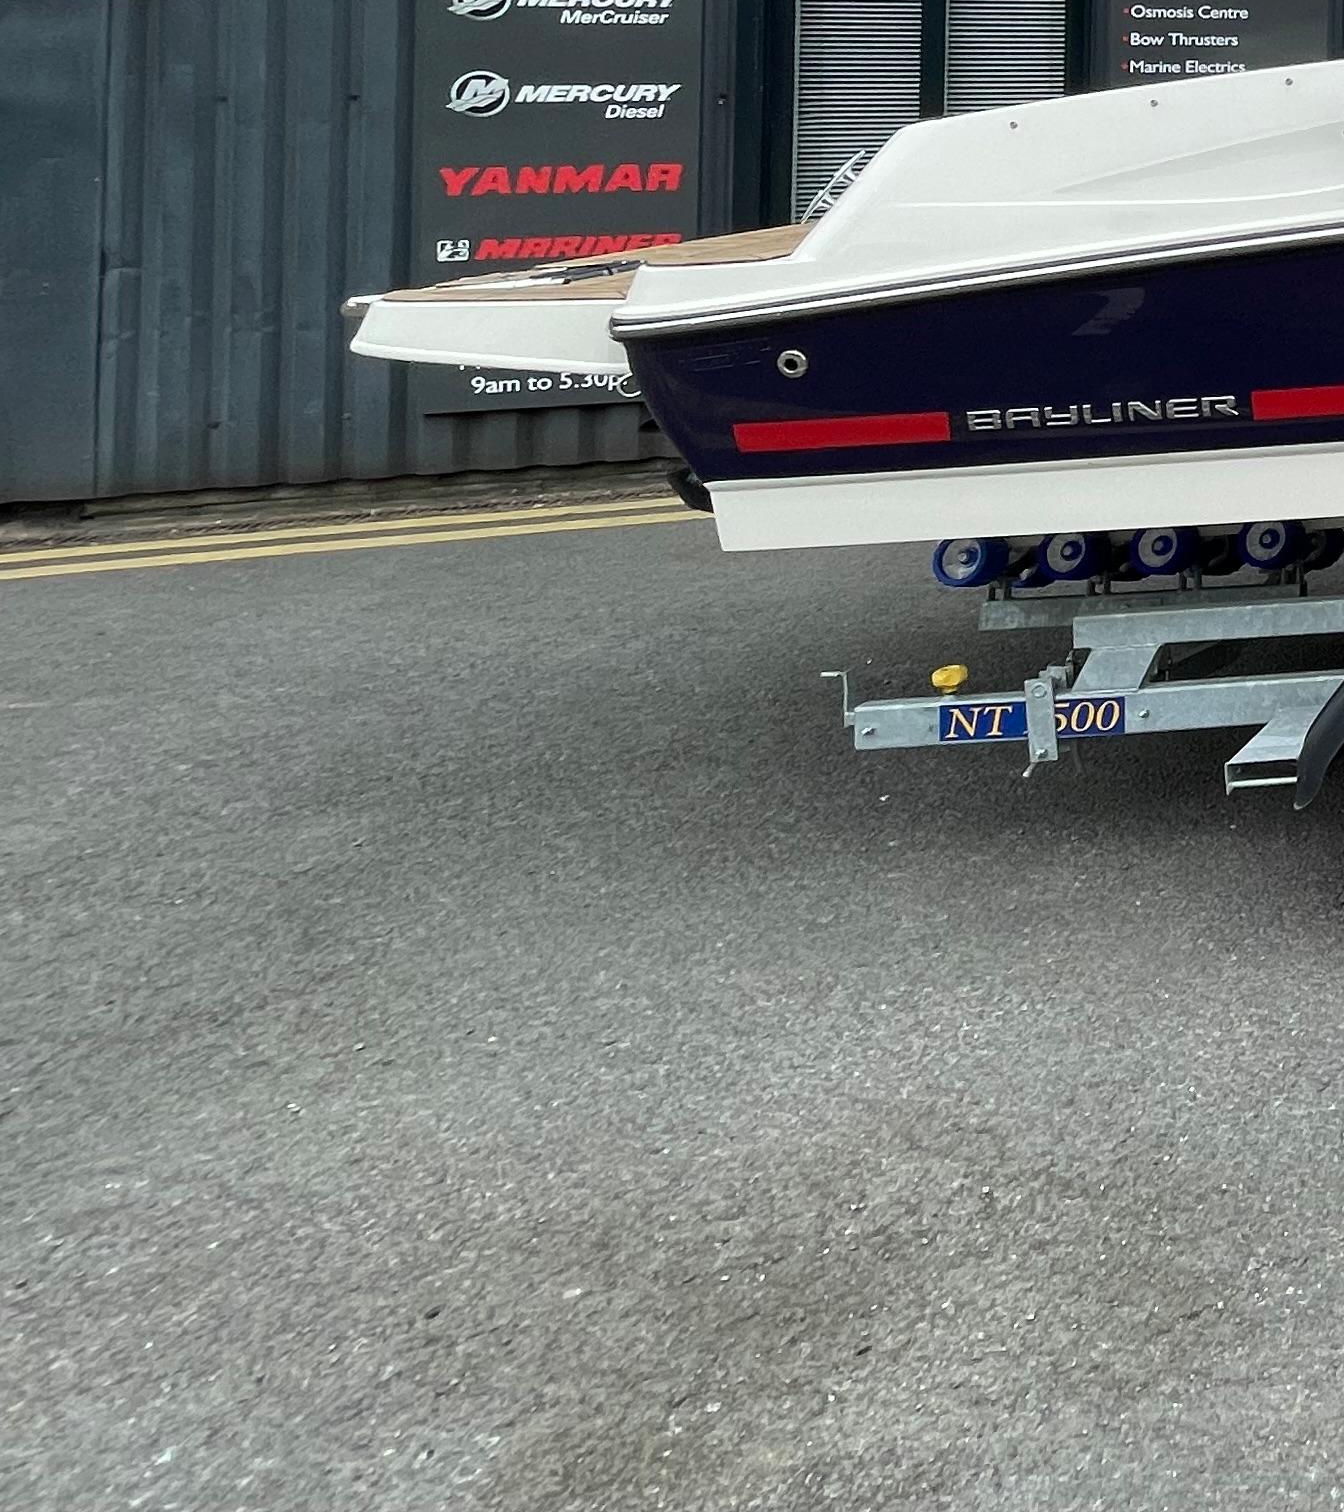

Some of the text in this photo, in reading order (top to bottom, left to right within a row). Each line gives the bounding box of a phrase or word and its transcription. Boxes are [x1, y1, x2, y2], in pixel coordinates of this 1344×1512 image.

[560, 9, 669, 25] MerCruiser
[1130, 6, 1249, 20] Osmosis Centre
[1130, 33, 1238, 47] Bow Thrusters
[1129, 61, 1246, 74] Marine Electrics
[514, 84, 683, 103] MERCURY
[605, 104, 666, 120] Diesel
[439, 163, 683, 196] YANMAR
[471, 373, 619, 394] 9am to 5.30p
[966, 395, 1239, 431] BAYLINER
[945, 700, 1120, 738] NT 500
